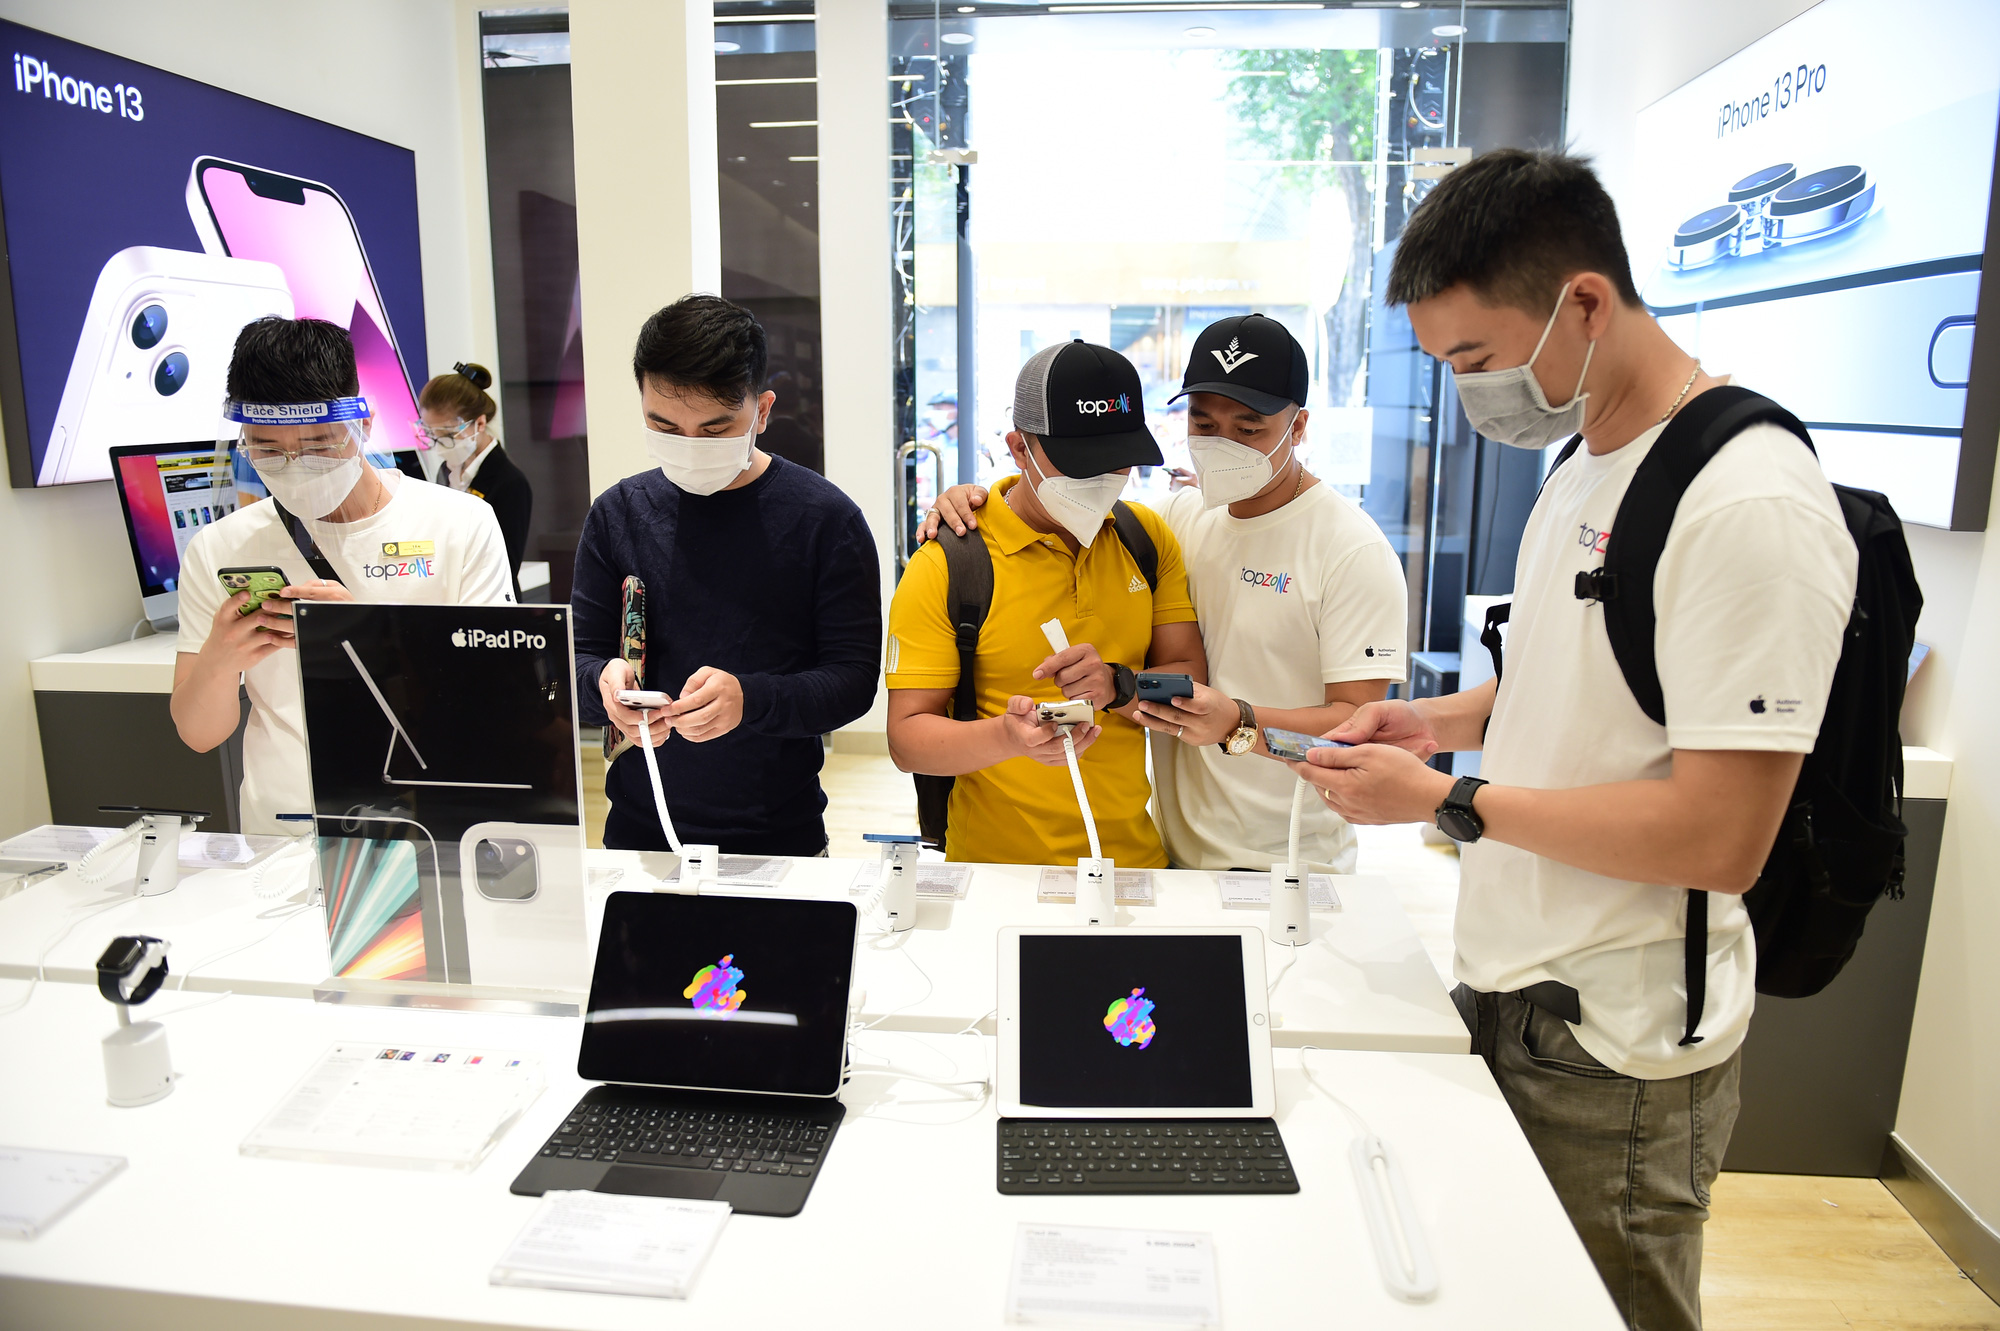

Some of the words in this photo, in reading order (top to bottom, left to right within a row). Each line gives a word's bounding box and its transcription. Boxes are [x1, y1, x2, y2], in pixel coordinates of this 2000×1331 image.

[13, 52, 113, 114] iPhone
[114, 83, 144, 121] 13
[1717, 91, 1771, 139] iPhone
[1774, 71, 1792, 112] 13
[1795, 63, 1827, 103] Pro
[245, 405, 274, 416] Face
[279, 404, 323, 416] Shield
[467, 629, 510, 649] iPad
[513, 630, 547, 650] Pro
